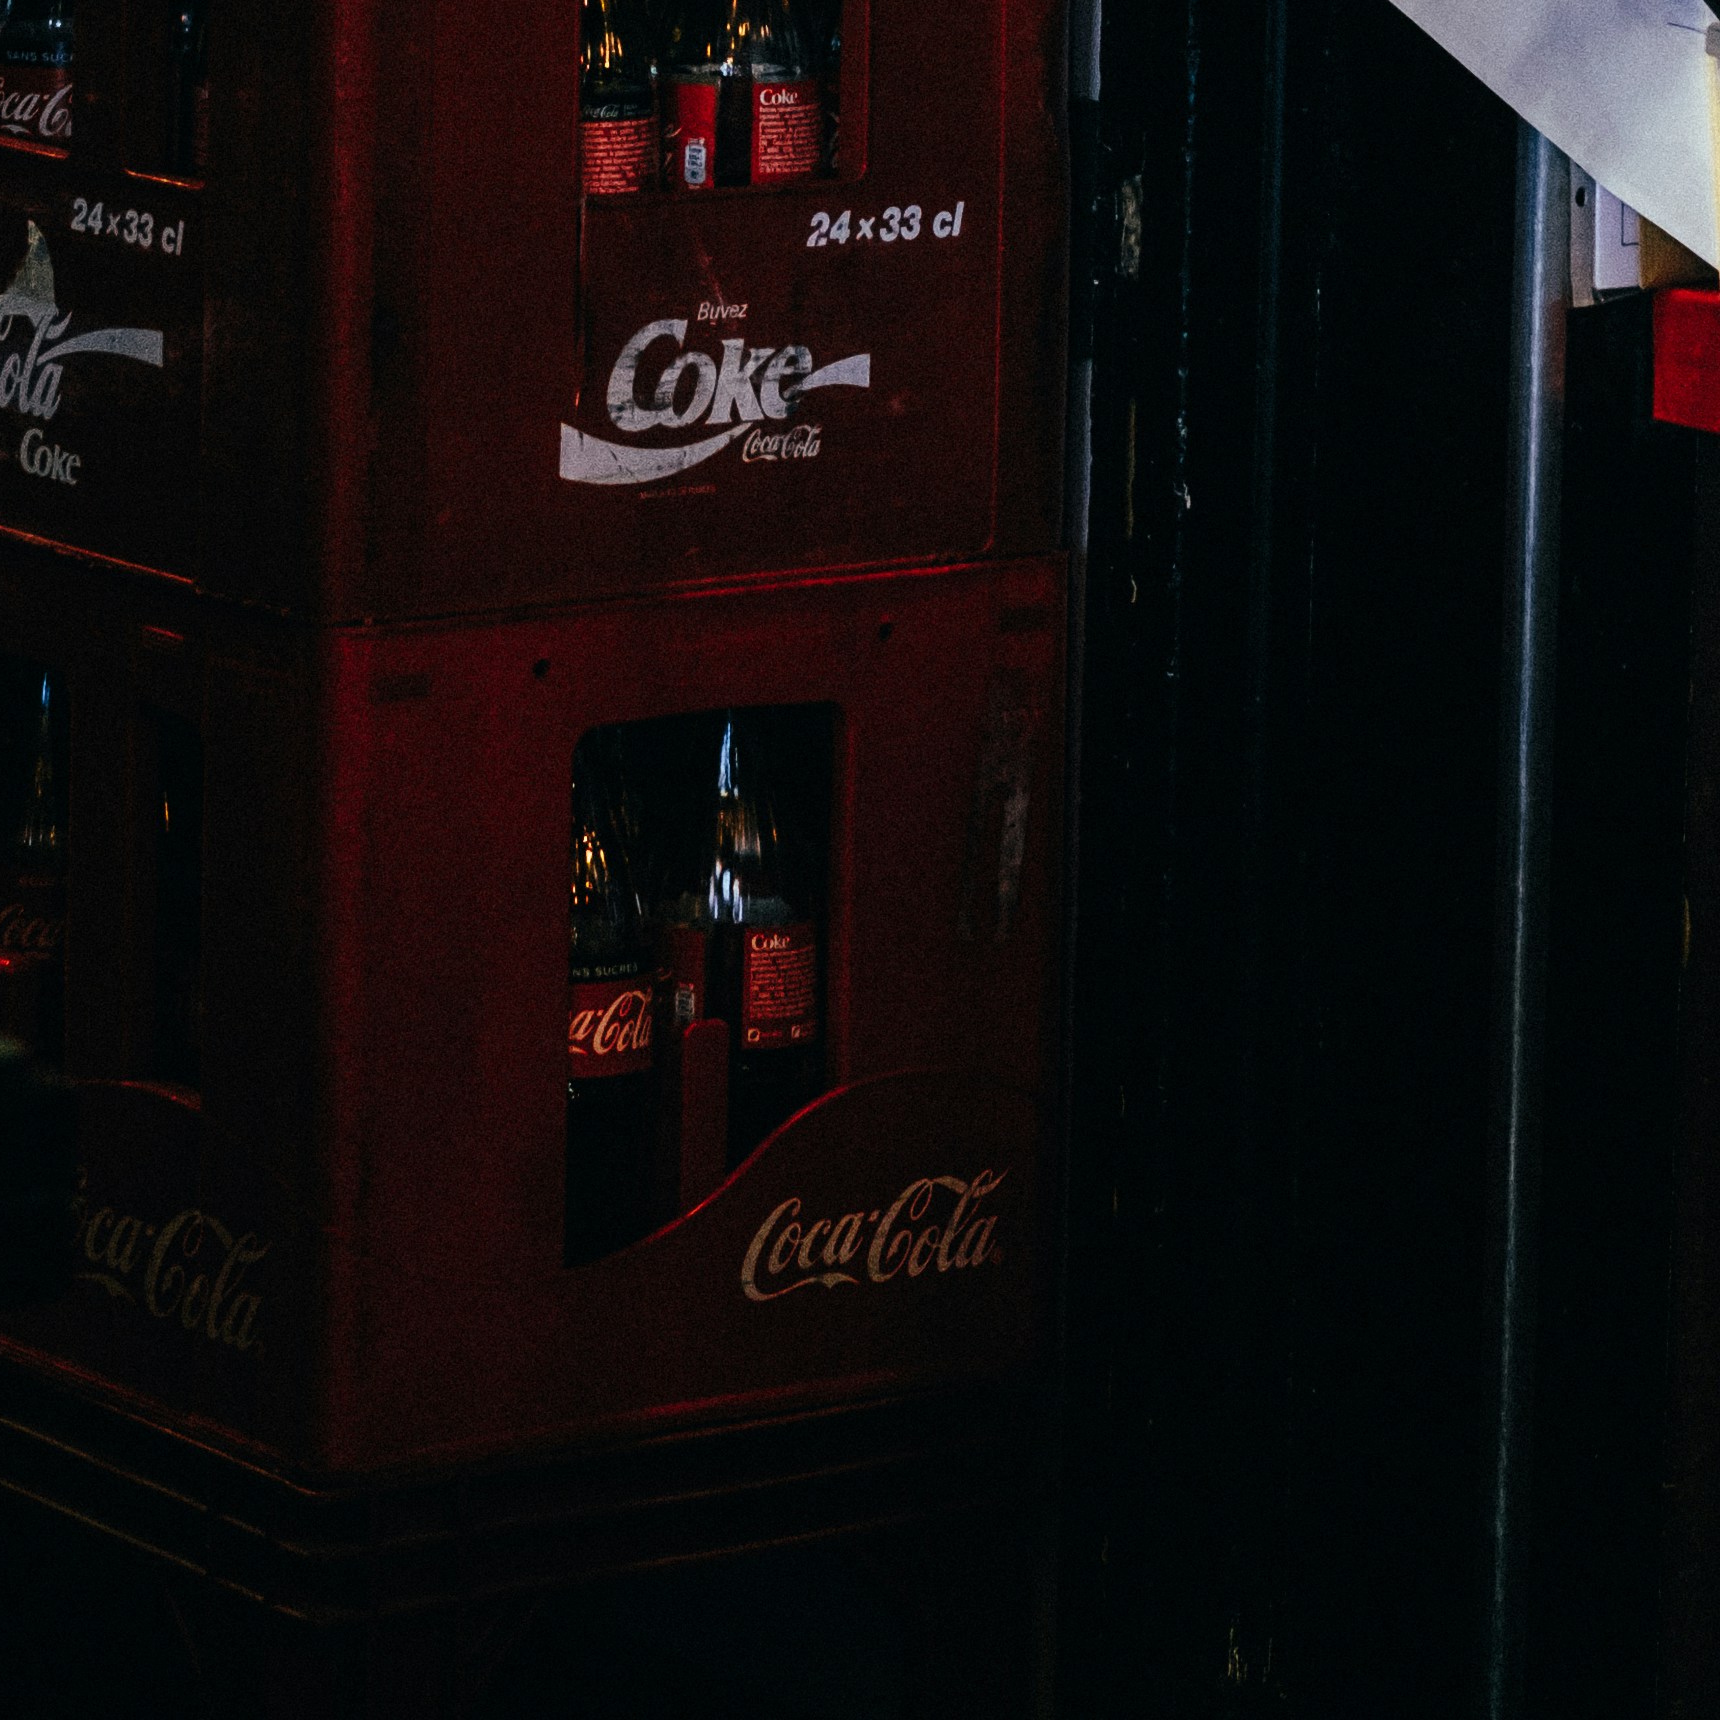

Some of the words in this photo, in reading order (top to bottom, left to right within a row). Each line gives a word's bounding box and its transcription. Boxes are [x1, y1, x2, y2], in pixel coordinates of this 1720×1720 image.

[758, 88, 799, 106] Coke
[161, 219, 185, 256] cl
[932, 201, 965, 239] cl
[697, 300, 749, 322] Buvez
[606, 318, 815, 433] Coke
[20, 428, 81, 486] Coke
[742, 424, 822, 463] Coca-Cola
[751, 934, 791, 952] Coke
[740, 1168, 1012, 1302] Coca-Cola
